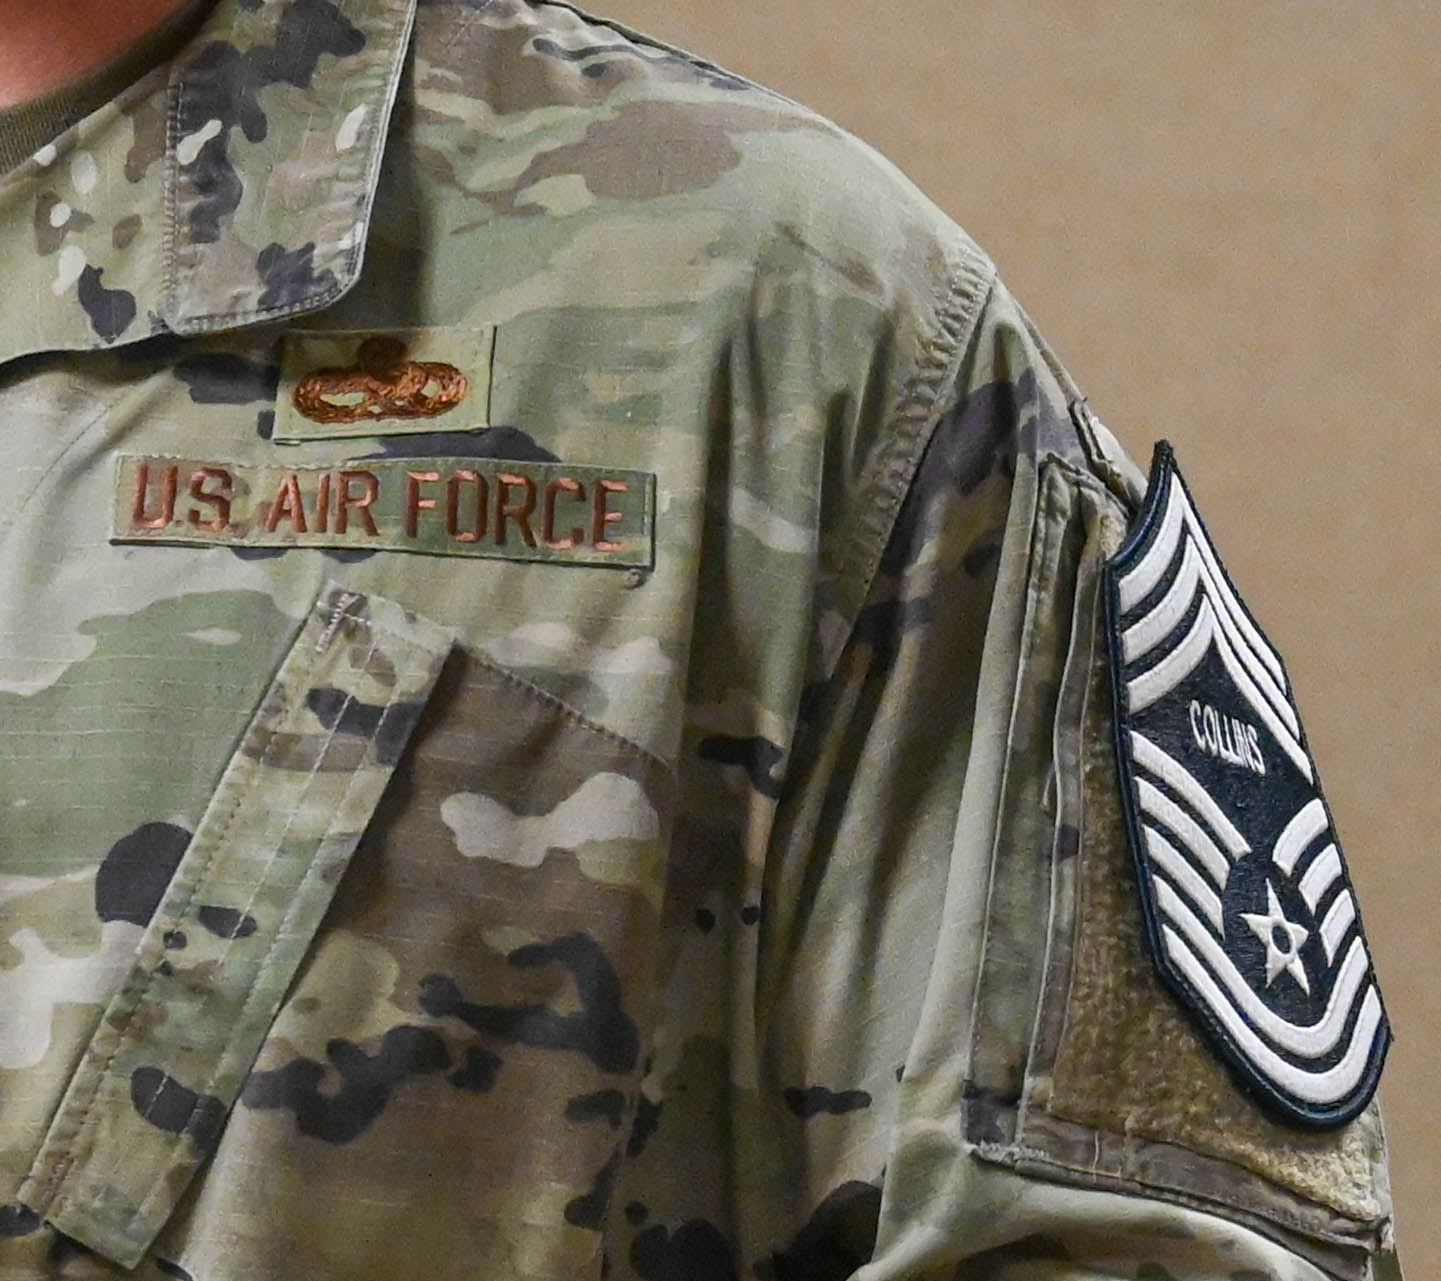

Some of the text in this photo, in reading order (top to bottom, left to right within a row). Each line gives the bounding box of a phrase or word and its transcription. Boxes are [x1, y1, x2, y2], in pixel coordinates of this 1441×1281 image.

[265, 470, 379, 537] AIR
[405, 468, 629, 553] FORCE
[1188, 698, 1266, 776] COLLINS
